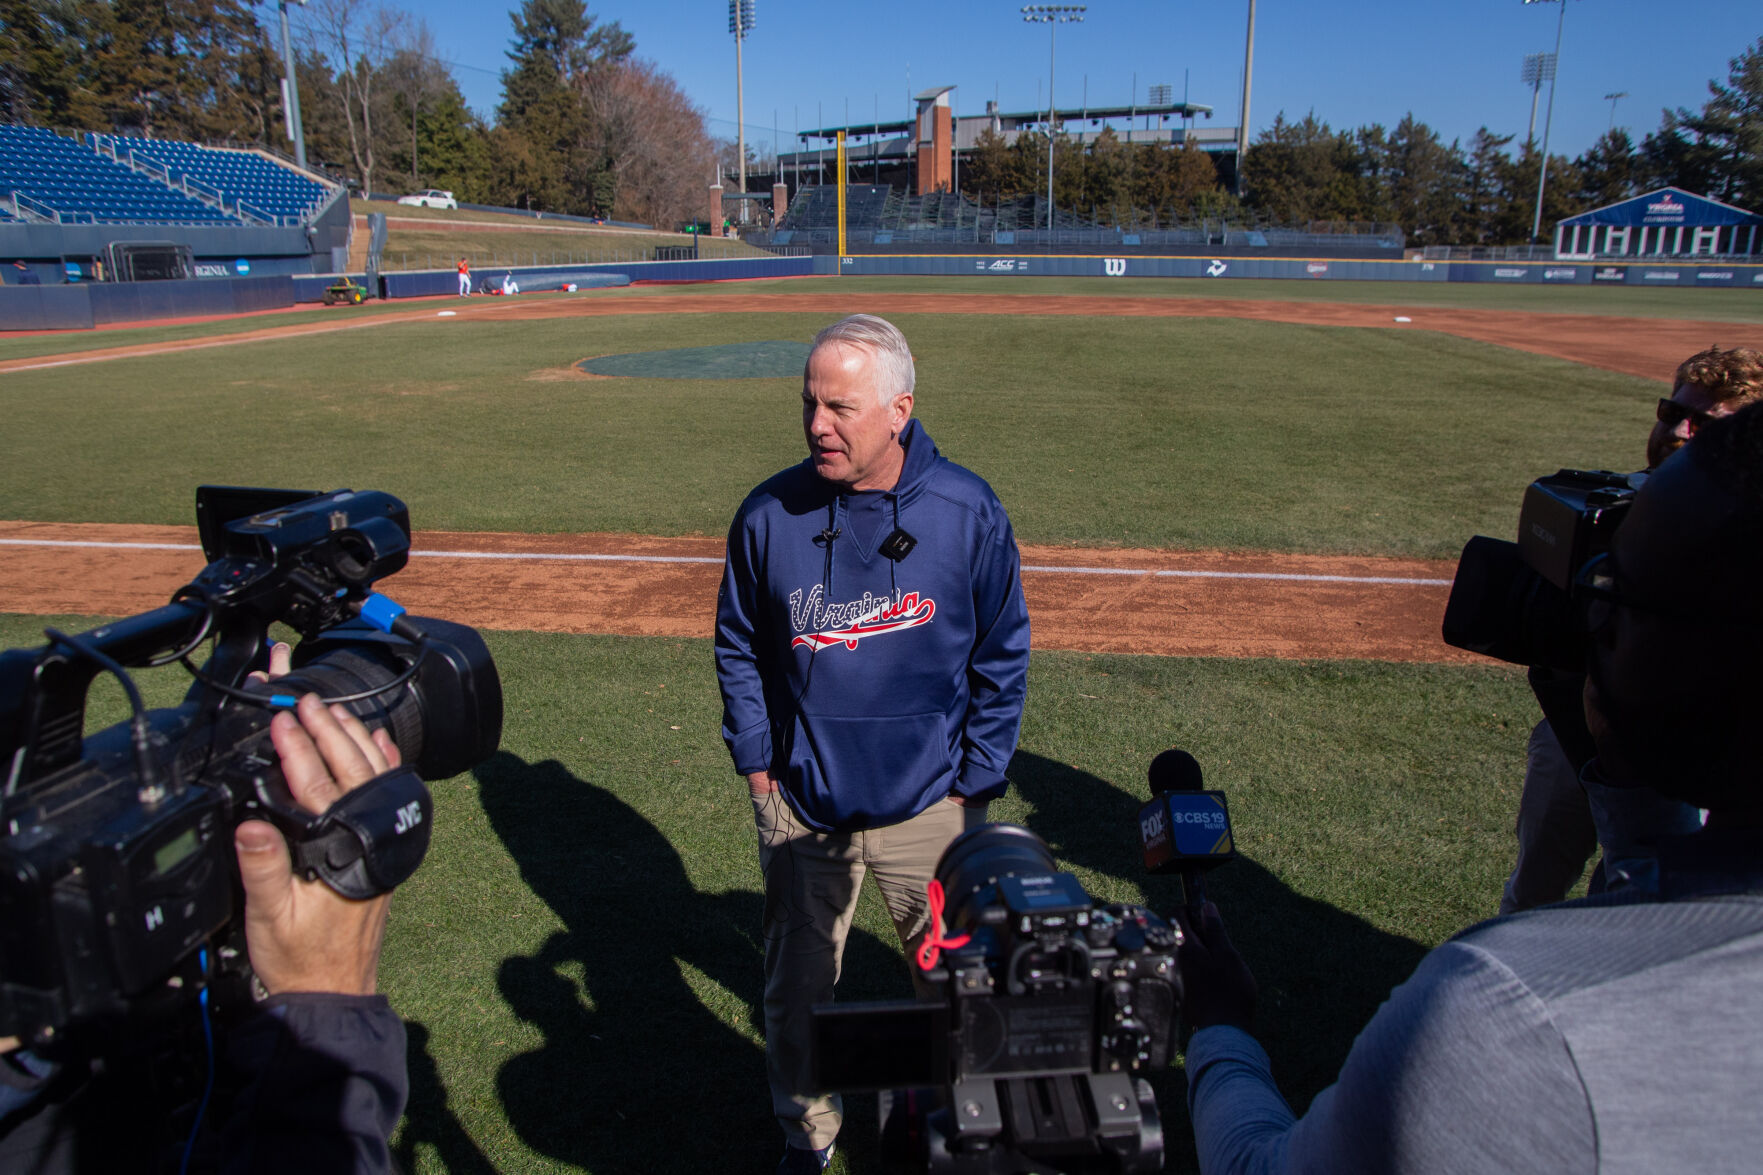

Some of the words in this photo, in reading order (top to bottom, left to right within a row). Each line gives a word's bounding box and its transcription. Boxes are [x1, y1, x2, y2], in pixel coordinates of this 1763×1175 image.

[789, 584, 935, 652] Virginia
[394, 800, 422, 834] JVC
[1141, 809, 1163, 843] FOX
[1184, 811, 1211, 824] CBS
[1210, 811, 1225, 824] 19
